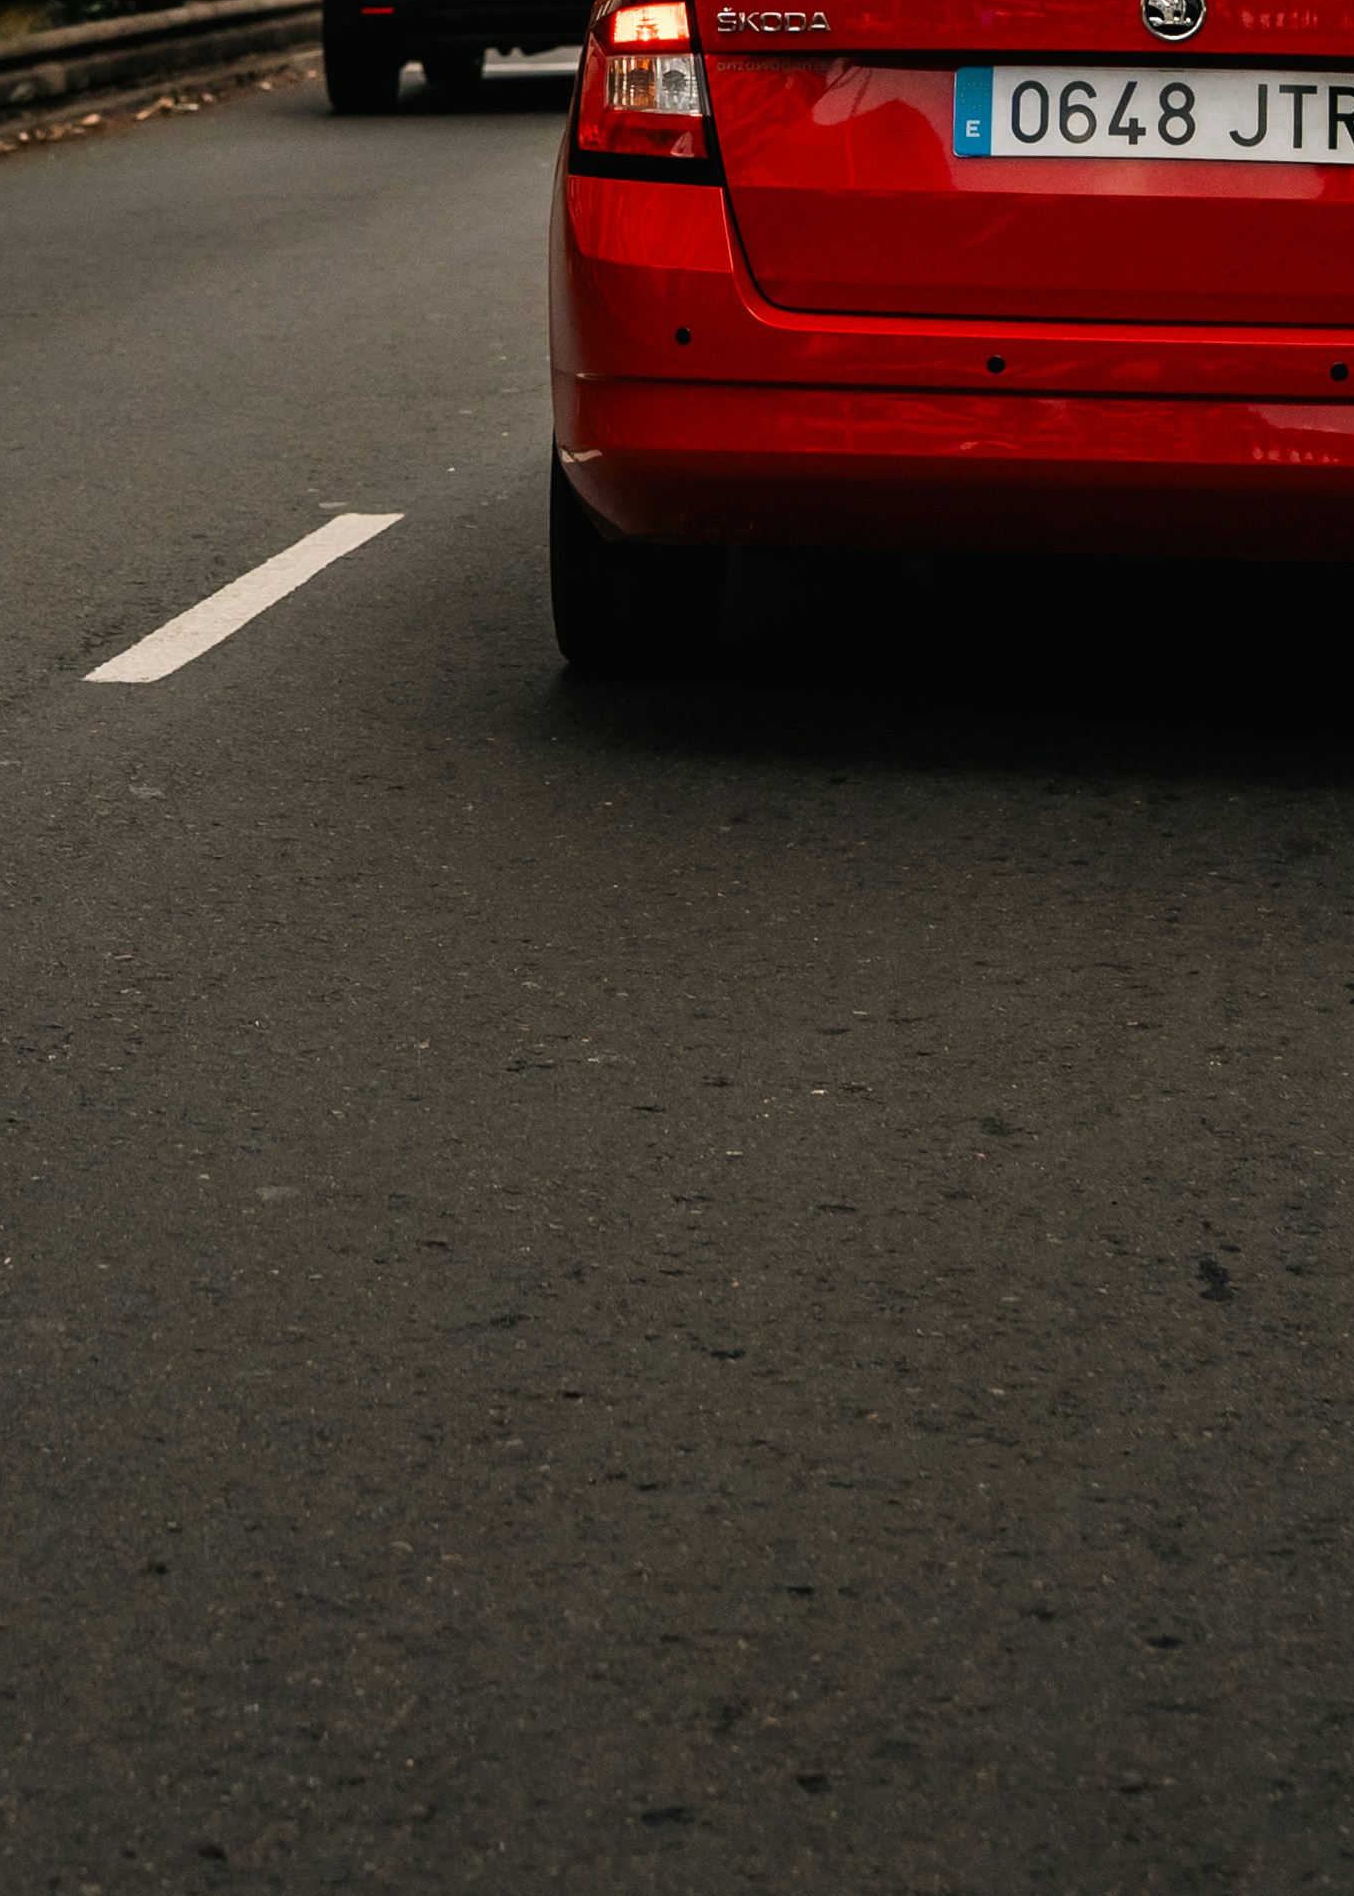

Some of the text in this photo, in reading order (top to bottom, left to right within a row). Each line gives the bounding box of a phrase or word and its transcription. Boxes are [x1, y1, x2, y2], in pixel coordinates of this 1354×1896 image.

[717, 7, 832, 32] ŠKODA
[1010, 80, 1197, 146] 0648
[965, 119, 981, 138] E
